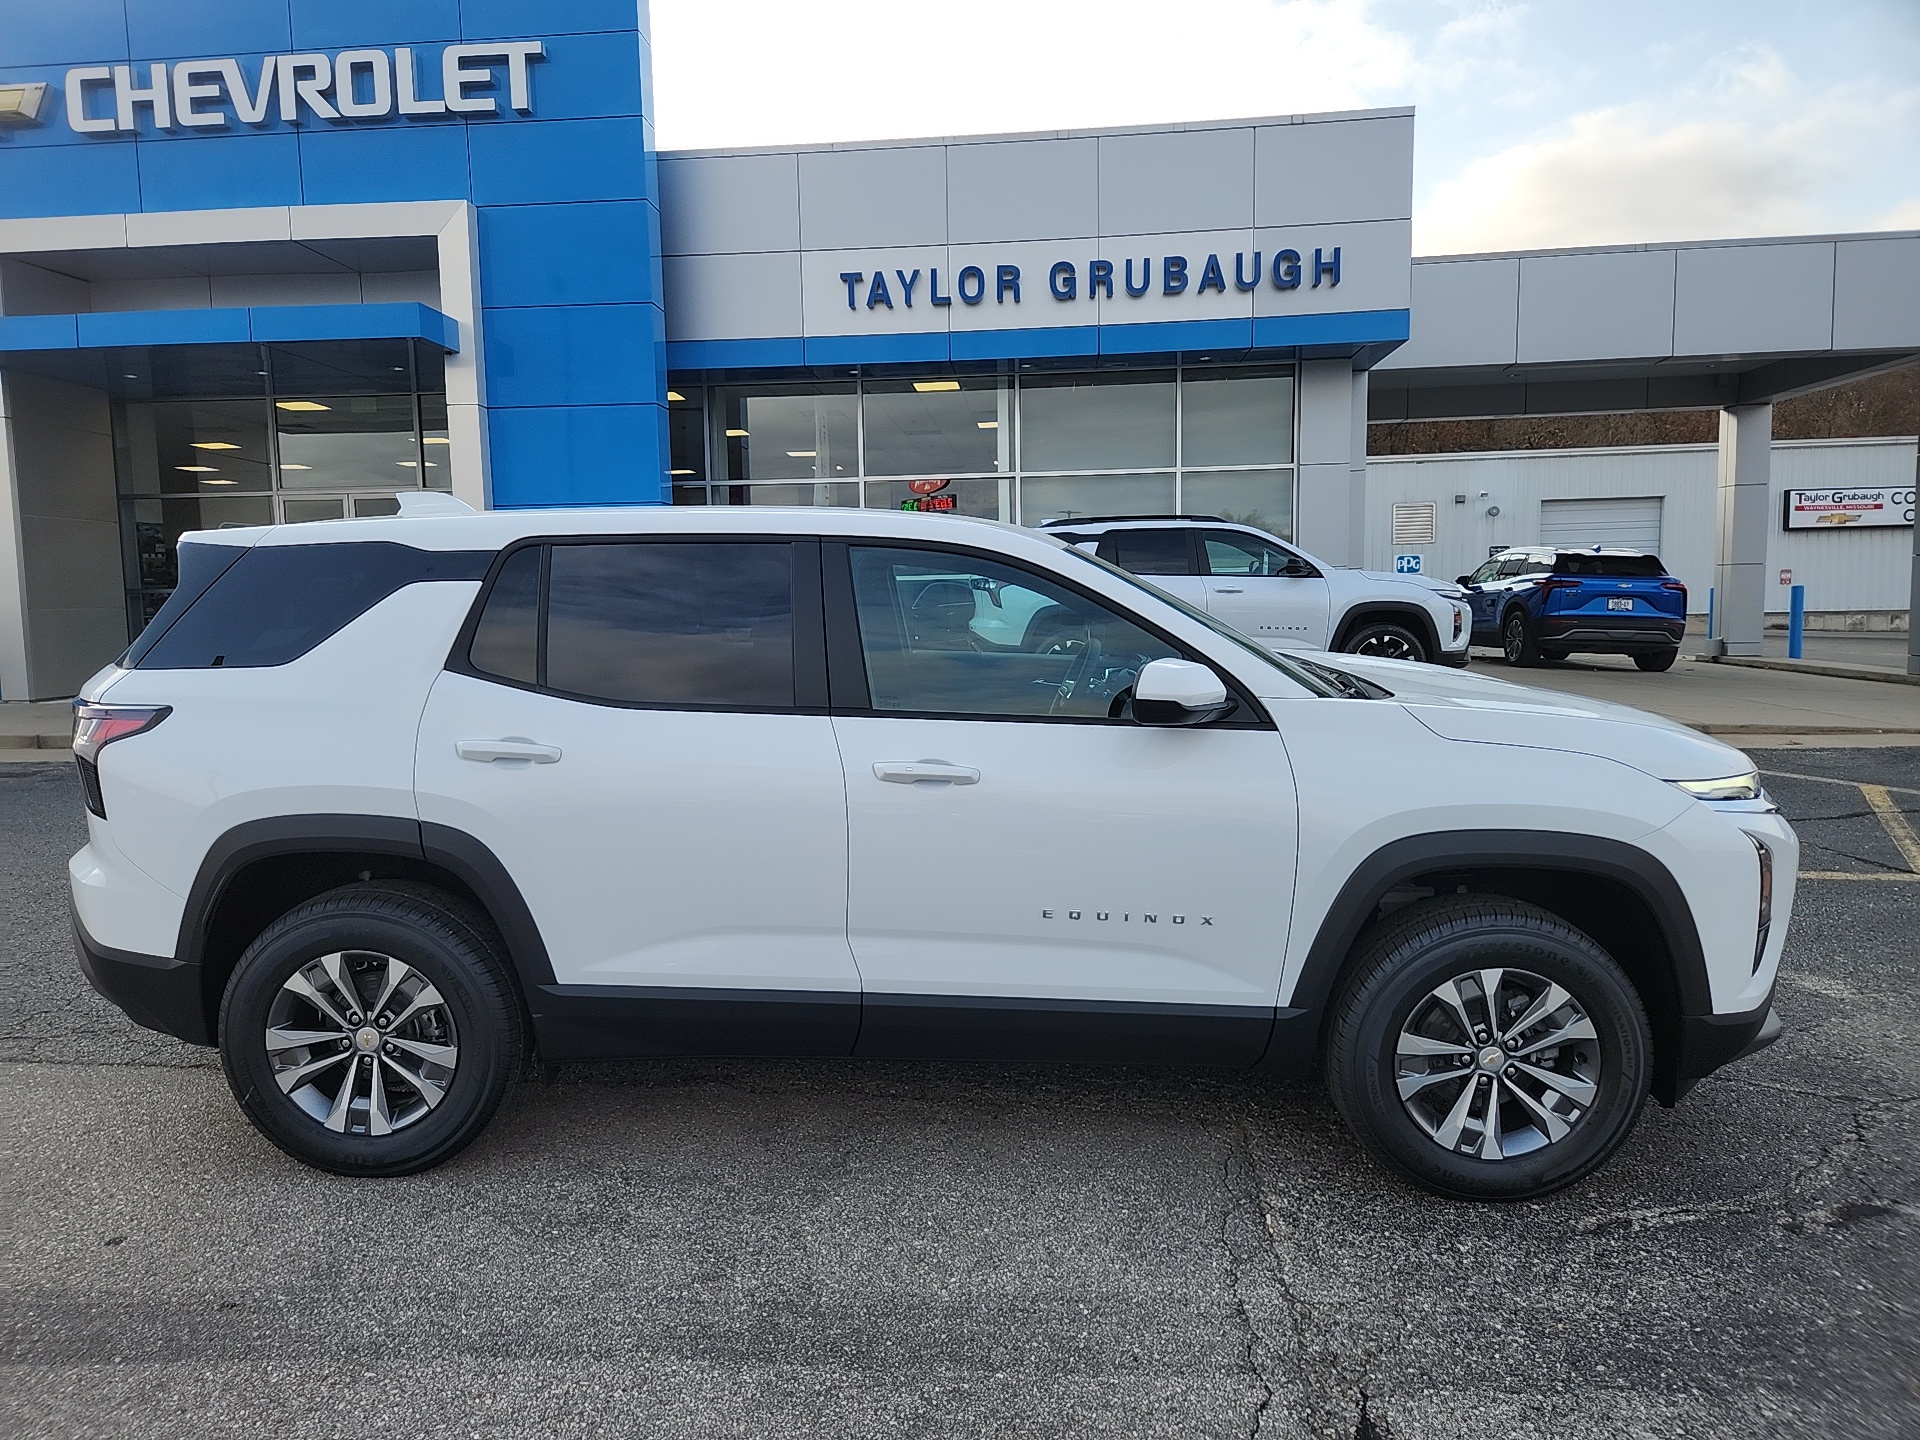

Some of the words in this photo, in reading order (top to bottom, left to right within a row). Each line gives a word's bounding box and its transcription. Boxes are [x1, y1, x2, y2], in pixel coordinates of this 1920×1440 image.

[65, 41, 546, 132] CHEVROLET
[839, 264, 1022, 311] TAYLOR
[1048, 246, 1343, 301] GRUBAUGH
[1795, 492, 1829, 505] Taylor
[1832, 491, 1884, 503] Grubaugh
[1398, 557, 1419, 572] PPG
[1042, 908, 1214, 926] EQUINOX
